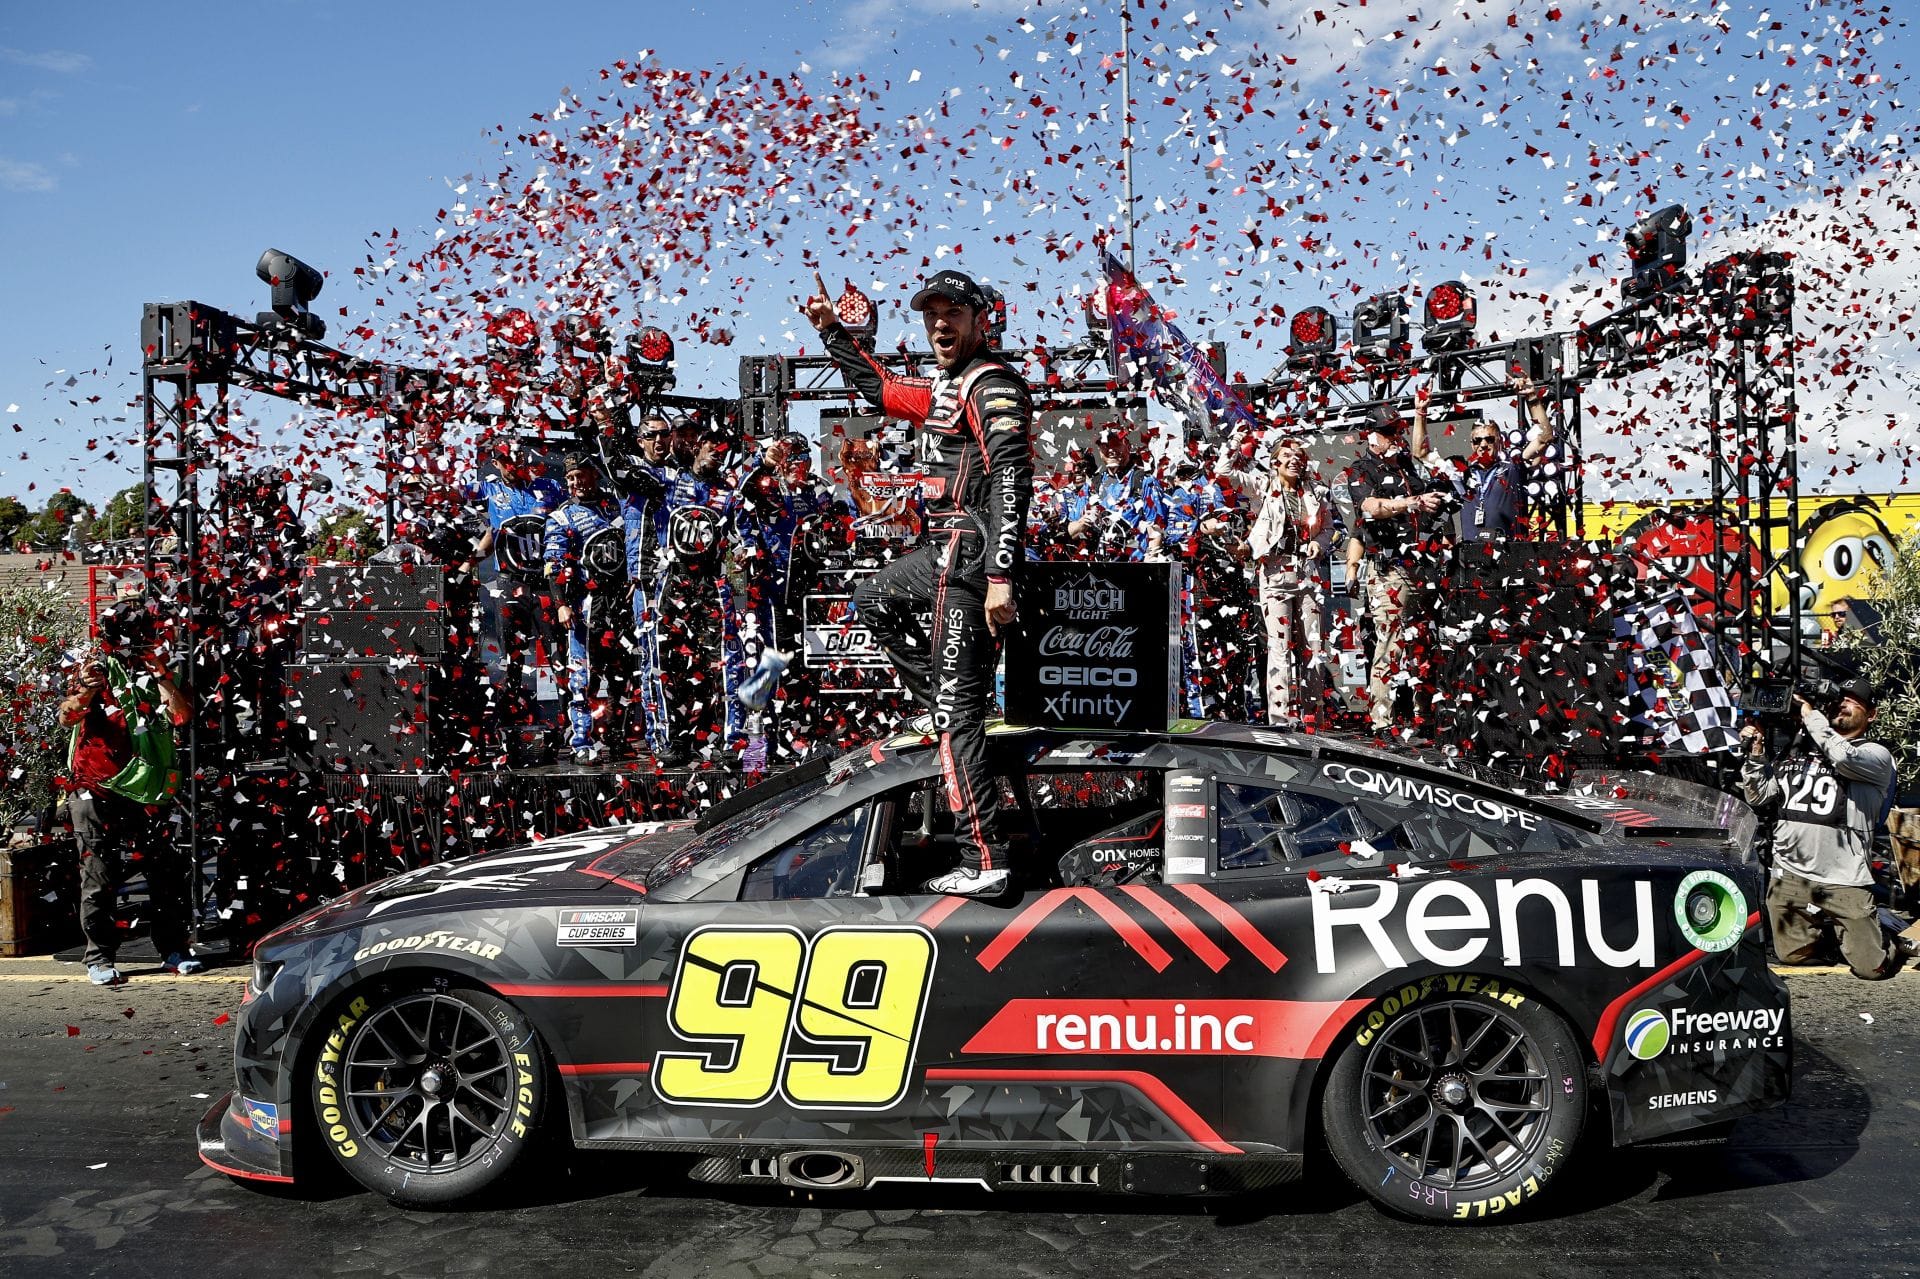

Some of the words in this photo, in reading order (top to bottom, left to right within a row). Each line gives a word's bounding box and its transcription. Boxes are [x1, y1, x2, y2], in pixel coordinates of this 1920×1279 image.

[944, 277, 966, 288] onx
[1002, 466, 1017, 514] HOMES
[995, 514, 1020, 569] onx
[1054, 589, 1126, 612] BUSCH
[1068, 609, 1109, 620] LIGHT
[942, 608, 963, 671] HOMES
[1039, 625, 1139, 658] Coca-Cola
[1039, 666, 1138, 687] GEICO
[934, 676, 958, 729] onx
[1043, 691, 1132, 721] xfinity
[1322, 763, 1539, 832] COMMSCOPE
[1778, 773, 1838, 816] 129
[1092, 849, 1127, 862] onx
[1129, 848, 1160, 858] HOMES
[567, 927, 588, 939] CUP
[589, 926, 626, 938] SERIES
[582, 911, 626, 923] NASCAR
[1306, 878, 1656, 974] Renu
[354, 930, 501, 961] GOODYEAR
[651, 925, 937, 1110] 99
[1356, 974, 1525, 1046] GOODYEAR
[1671, 1007, 1784, 1036] Freeway
[1036, 1003, 1253, 1051] renu.inc
[1671, 1037, 1784, 1055] INSURANCE
[317, 996, 369, 1158] GOODYEAR
[1563, 1077, 1574, 1094] 53
[514, 1051, 532, 1140] EAGLE
[1649, 1090, 1717, 1109] SIEMENS
[1453, 1176, 1540, 1219] EAGLE
